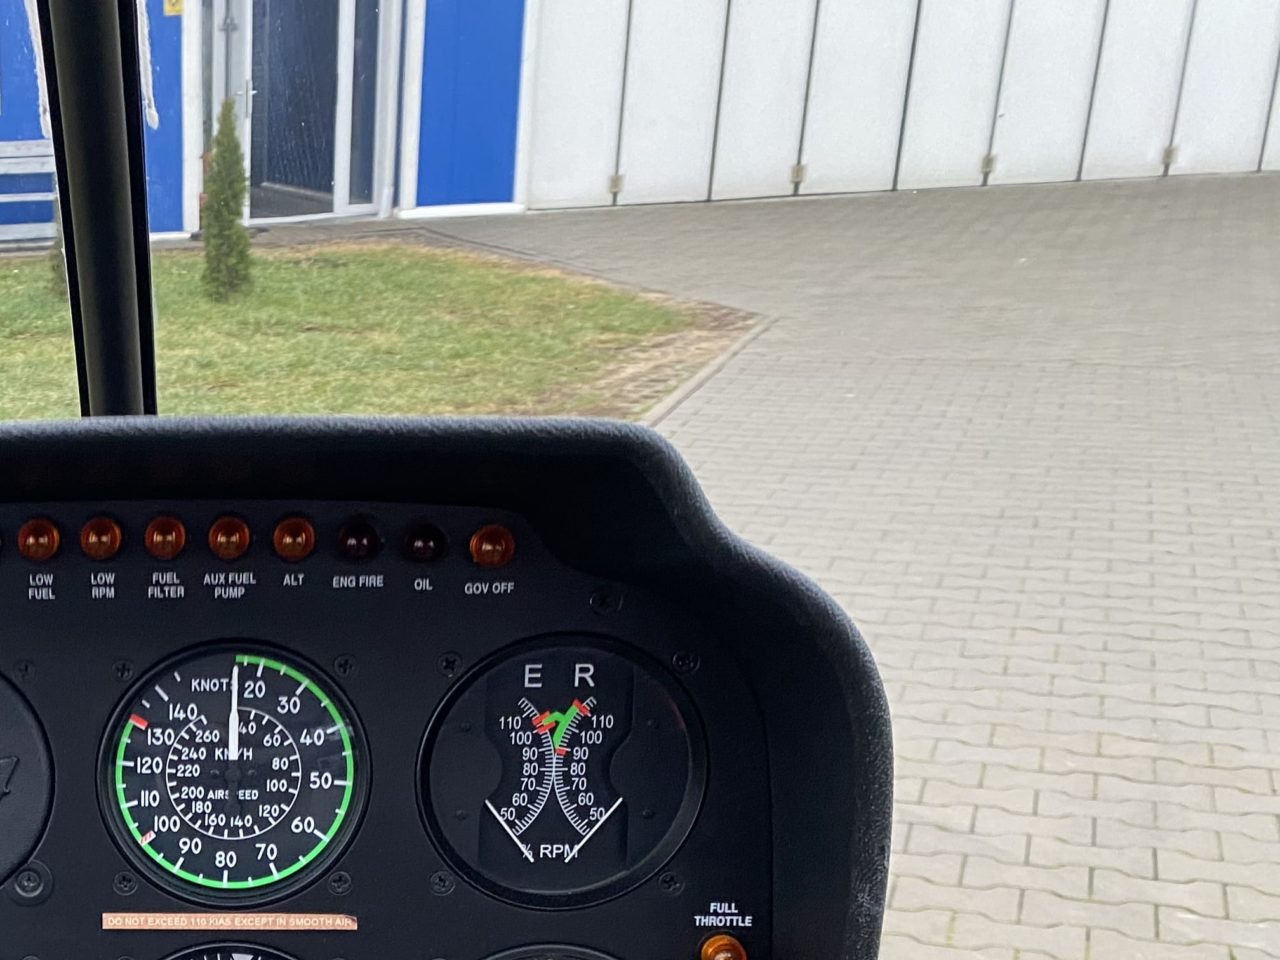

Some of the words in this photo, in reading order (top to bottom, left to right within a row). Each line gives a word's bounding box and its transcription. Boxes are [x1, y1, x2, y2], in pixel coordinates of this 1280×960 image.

[29, 574, 53, 586] LOW
[91, 572, 115, 585] LOW
[152, 572, 180, 584] FUEL
[203, 573, 225, 585] AUX
[228, 572, 256, 584] FUEL
[283, 573, 305, 586] ALT
[332, 576, 356, 588] ENG
[359, 575, 384, 587] FIRE
[414, 578, 433, 591] OIL
[28, 588, 55, 600] FUEL
[91, 587, 115, 599] RPM
[148, 586, 185, 598] FILTER
[214, 587, 245, 599] PUMP
[464, 582, 489, 594] GOV
[492, 582, 515, 594] OFF
[524, 664, 543, 687] E
[574, 663, 595, 687] R
[192, 678, 238, 692] KNOT
[243, 680, 266, 698] 20
[300, 729, 324, 746] 40
[309, 772, 332, 789] 50
[154, 816, 181, 833] 100
[540, 844, 579, 858] RPM
[215, 851, 237, 868] 80
[710, 902, 738, 913] FULL
[108, 917, 122, 926] DO
[125, 917, 144, 926] NOT
[148, 918, 187, 926] EXCEED
[210, 917, 231, 926] KIAS
[234, 917, 272, 926] EXCEPT
[276, 918, 286, 926] IN
[289, 918, 333, 926] SMOOTH
[335, 918, 352, 926] AIR
[694, 916, 752, 926] THROTTLE
